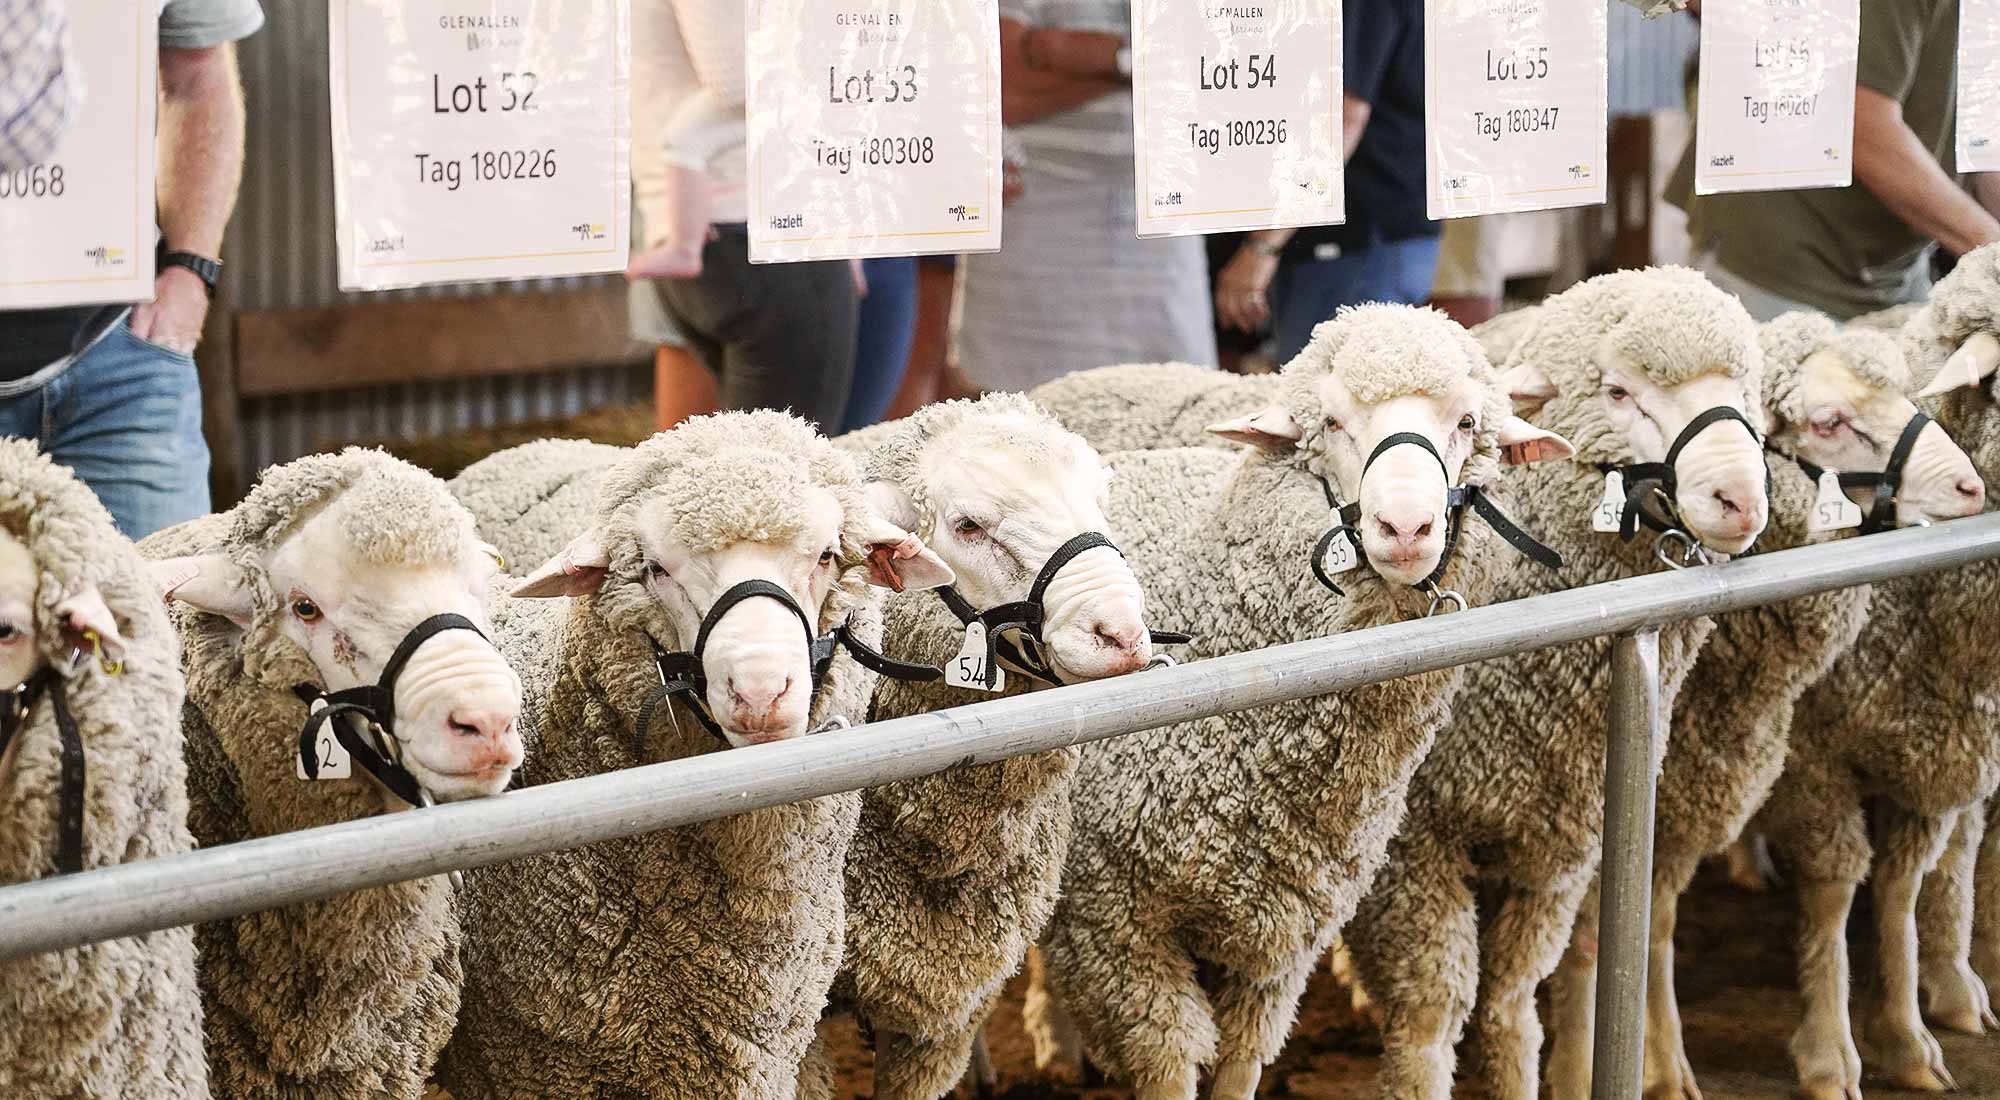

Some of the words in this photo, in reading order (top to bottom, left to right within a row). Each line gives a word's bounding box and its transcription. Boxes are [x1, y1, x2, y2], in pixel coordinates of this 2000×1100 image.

[439, 15, 519, 29] GLENALLEN
[836, 13, 903, 26] GLENALEN
[1201, 55, 1239, 90] Lot
[1247, 54, 1276, 89] 54
[1486, 49, 1518, 81] Lot
[1525, 47, 1548, 80] 55
[434, 74, 487, 113] Lot
[502, 71, 538, 111] 52
[830, 66, 874, 103] Lot
[885, 65, 918, 103] 53
[1475, 112, 1502, 142] Tag
[1507, 107, 1560, 133] 180347
[1743, 96, 1768, 124] Tag
[1188, 123, 1219, 155] Tag
[1226, 119, 1287, 147] 180236
[415, 153, 461, 191] Tag
[471, 149, 556, 181] 180226
[813, 140, 851, 174] Tag
[861, 136, 934, 164] 180308
[770, 214, 803, 229] Hazlett
[1819, 500, 1843, 525] 57
[1330, 538, 1347, 566] 55
[960, 656, 986, 686] 54
